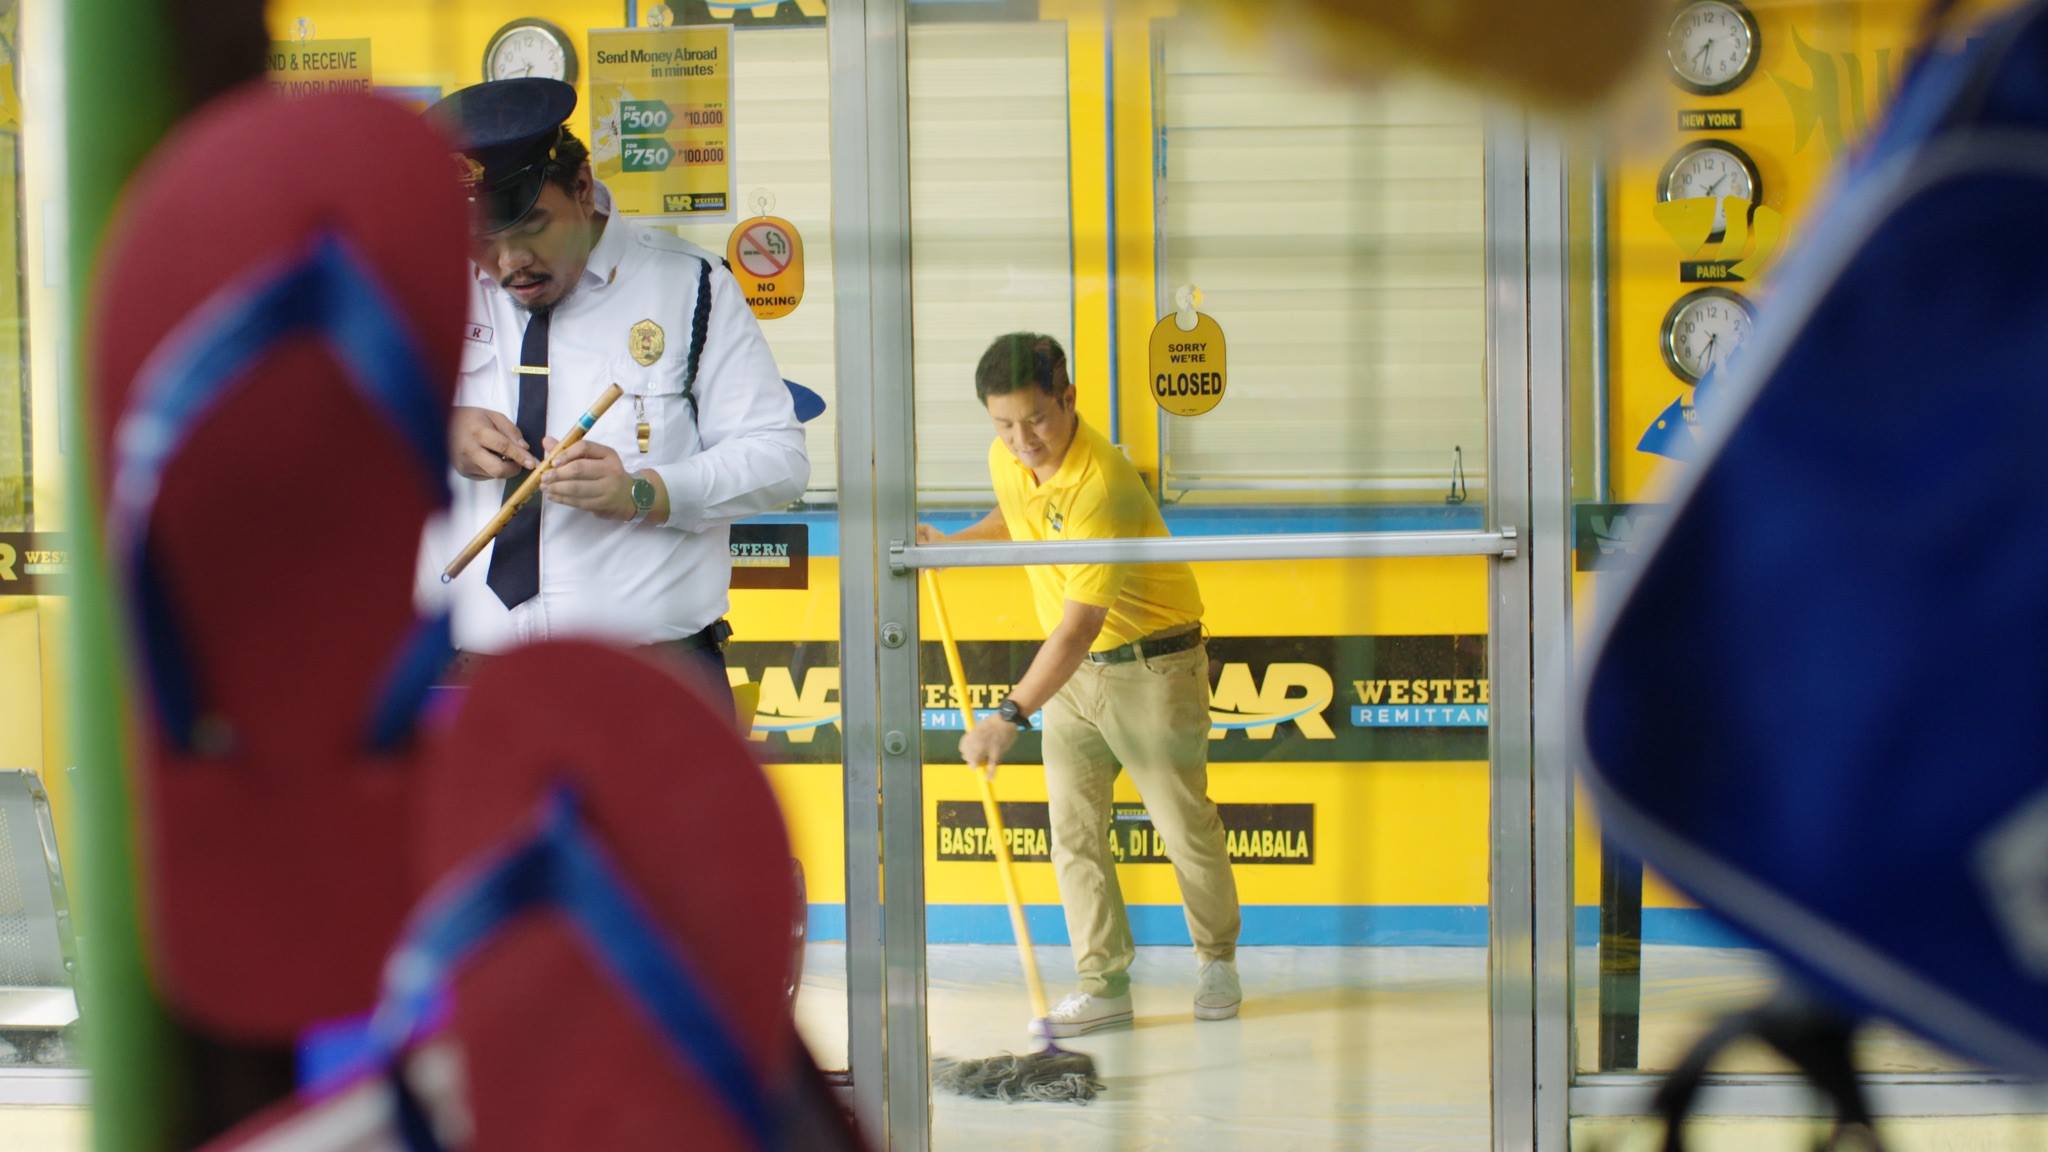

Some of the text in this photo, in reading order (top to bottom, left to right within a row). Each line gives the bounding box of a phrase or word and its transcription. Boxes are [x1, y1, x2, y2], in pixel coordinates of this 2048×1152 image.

[267, 54, 286, 71] ND
[303, 52, 357, 70] RECEIVE
[597, 47, 717, 64] Send Money Abroad
[651, 64, 662, 77] in
[1707, 114, 1737, 126] YORK
[1696, 265, 1727, 278] PARIS
[757, 283, 775, 292] NO
[746, 297, 796, 306] MOKING
[472, 328, 481, 338] R
[1168, 343, 1207, 353] SORRY
[1170, 354, 1206, 363] WE'RE
[1156, 372, 1222, 396] CLOSED
[730, 543, 788, 556] STERN
[1360, 708, 1488, 723] REMITTAN
[1130, 830, 1147, 856] DI
[1224, 830, 1308, 858] AAABALA
